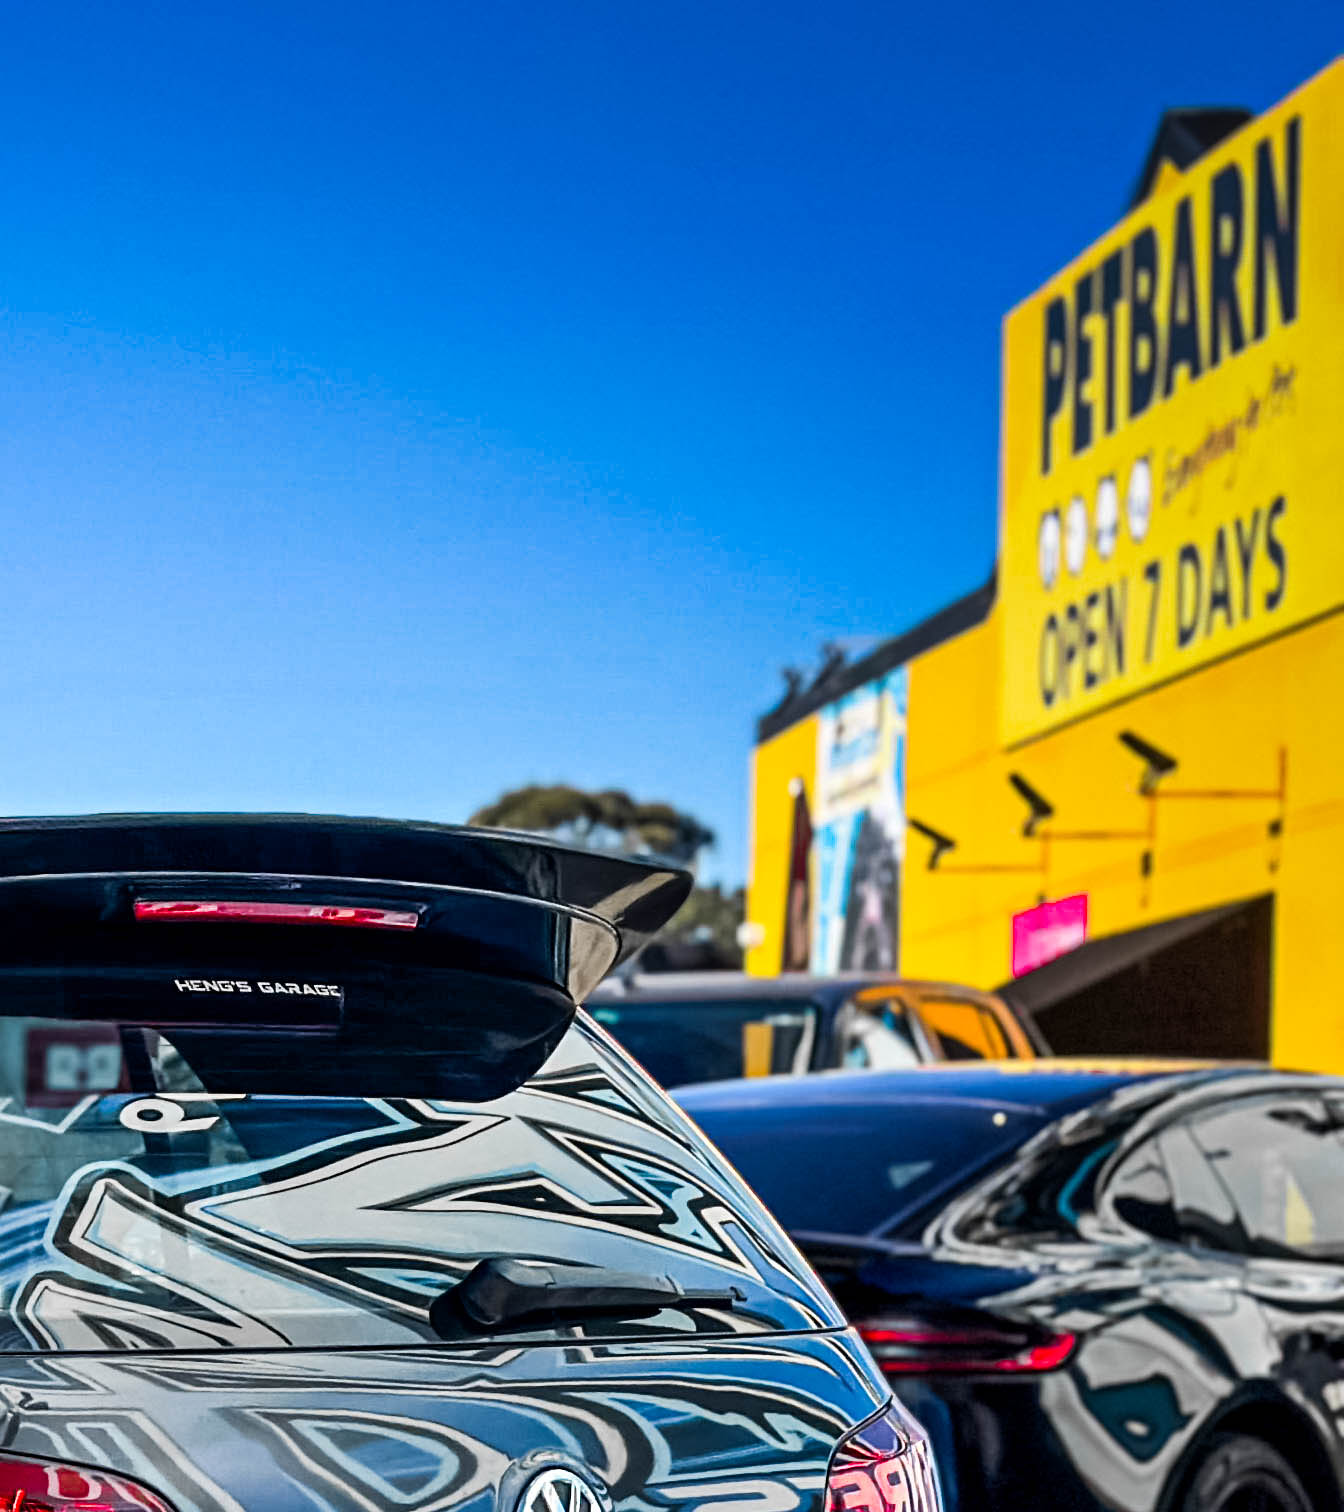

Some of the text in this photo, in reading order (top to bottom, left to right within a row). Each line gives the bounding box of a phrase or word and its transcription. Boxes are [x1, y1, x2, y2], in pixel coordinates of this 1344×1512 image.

[1041, 112, 1300, 476] PETBARN
[1038, 490, 1287, 707] OPEN 7 DAYS
[173, 978, 342, 997] HENG'S GARAGE
